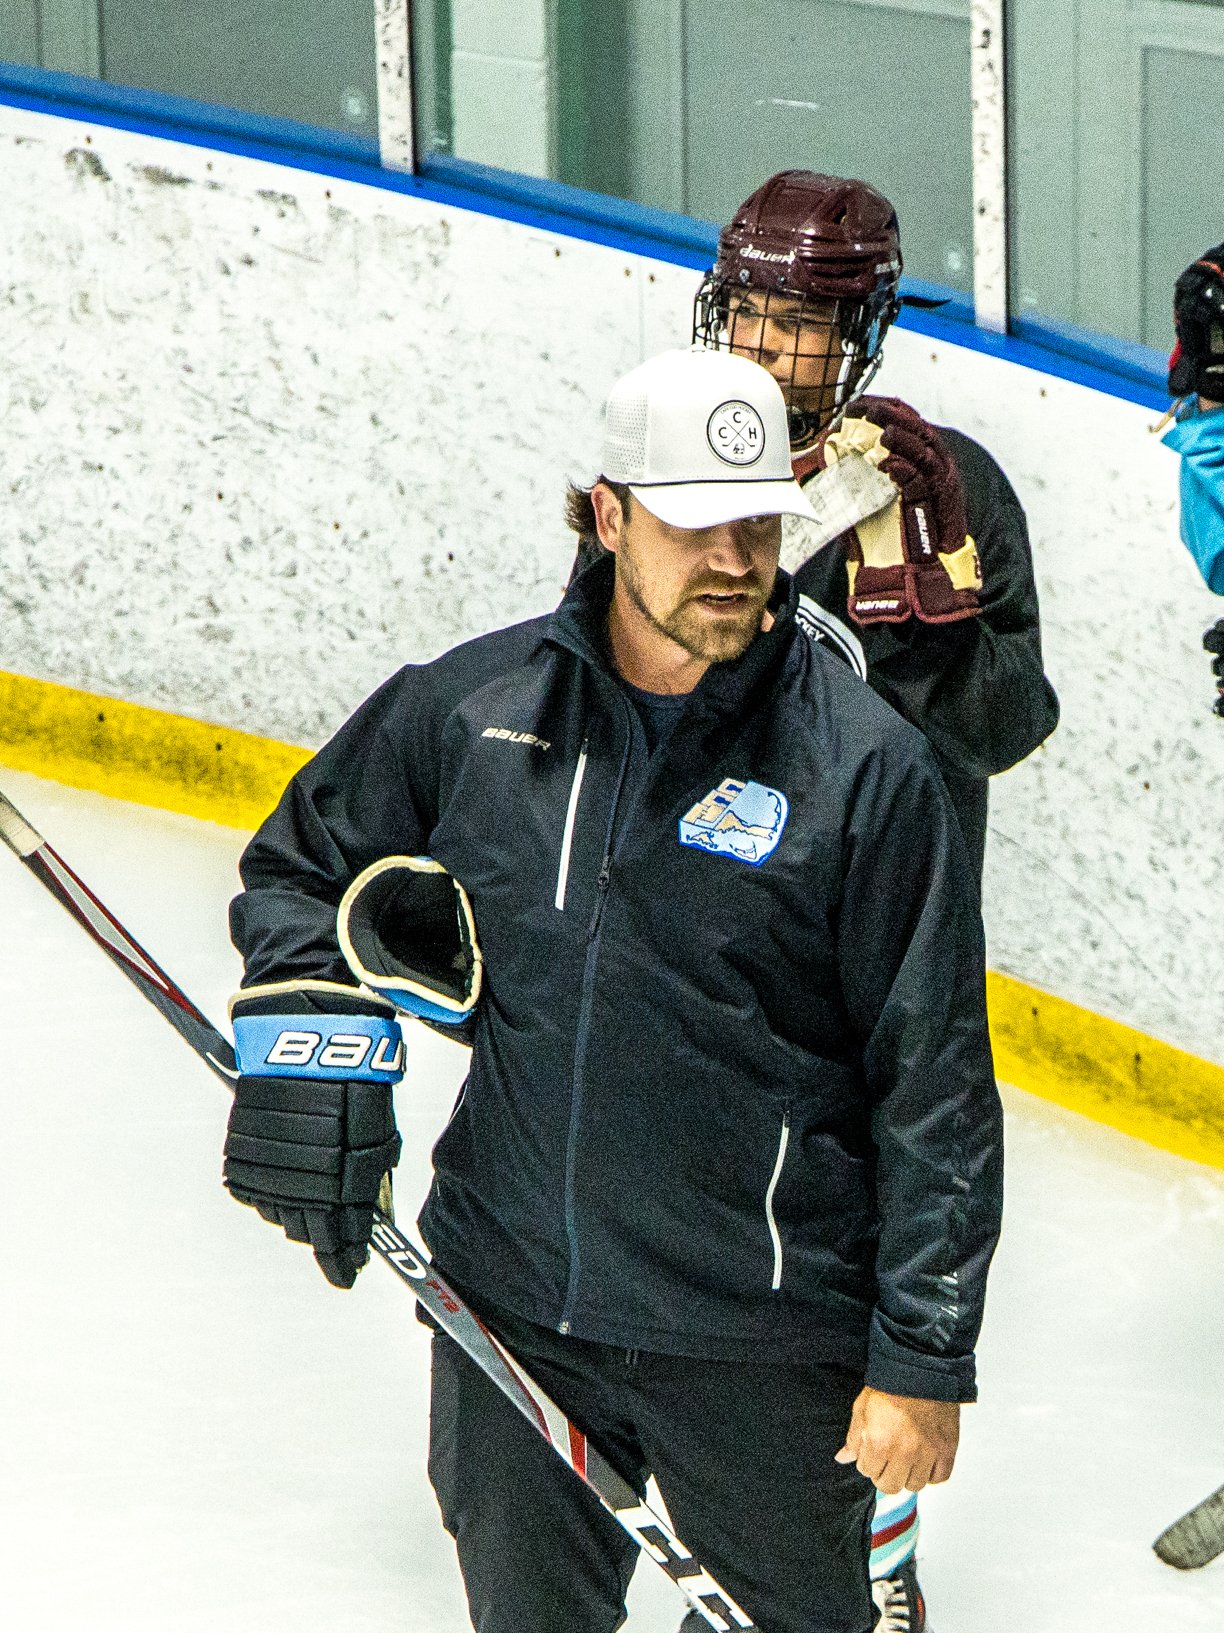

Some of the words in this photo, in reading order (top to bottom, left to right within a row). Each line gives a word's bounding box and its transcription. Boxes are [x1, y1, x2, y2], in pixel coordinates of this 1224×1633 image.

[732, 411, 742, 424] C
[718, 426, 728, 439] C
[748, 427, 757, 440] H
[481, 727, 551, 751] BAUER
